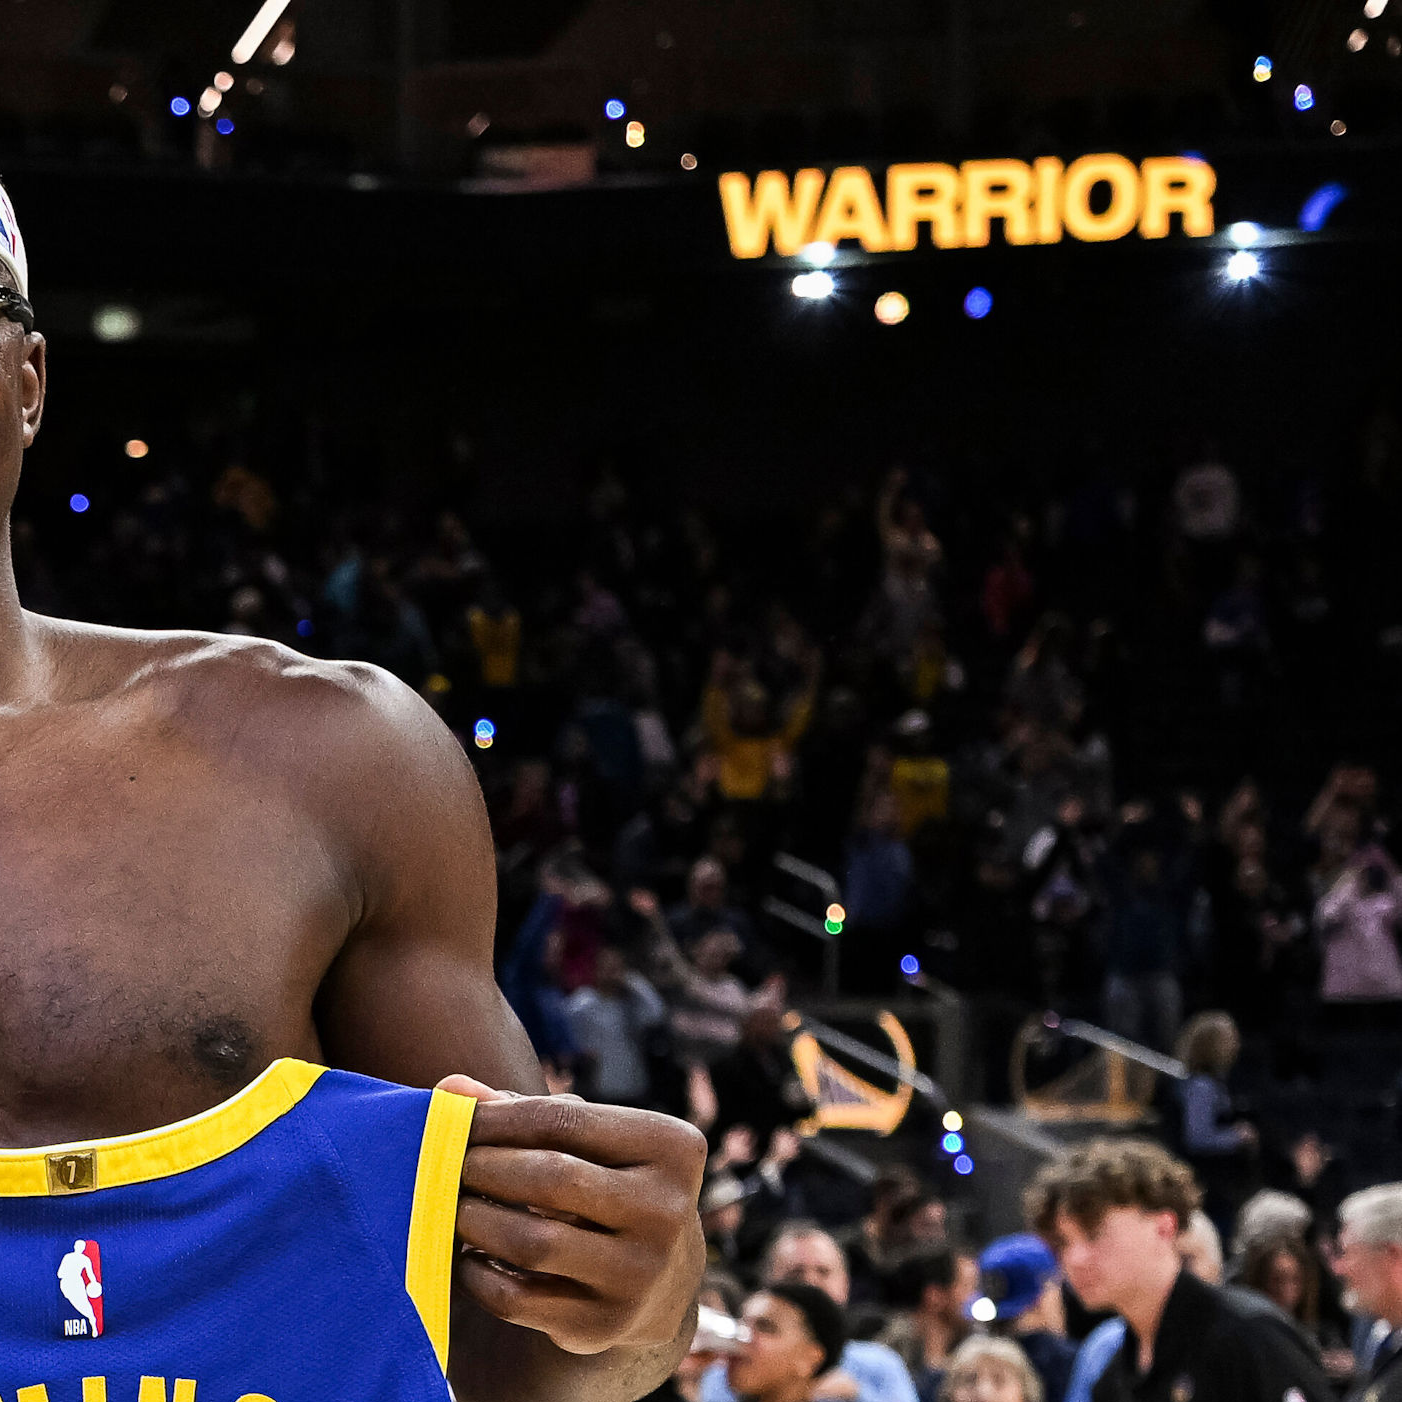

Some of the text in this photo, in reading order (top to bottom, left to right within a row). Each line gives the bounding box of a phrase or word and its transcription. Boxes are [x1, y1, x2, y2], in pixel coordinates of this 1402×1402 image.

[719, 152, 1218, 259] WARRIOR
[66, 1160, 77, 1184] 7
[64, 1318, 88, 1337] NBA
